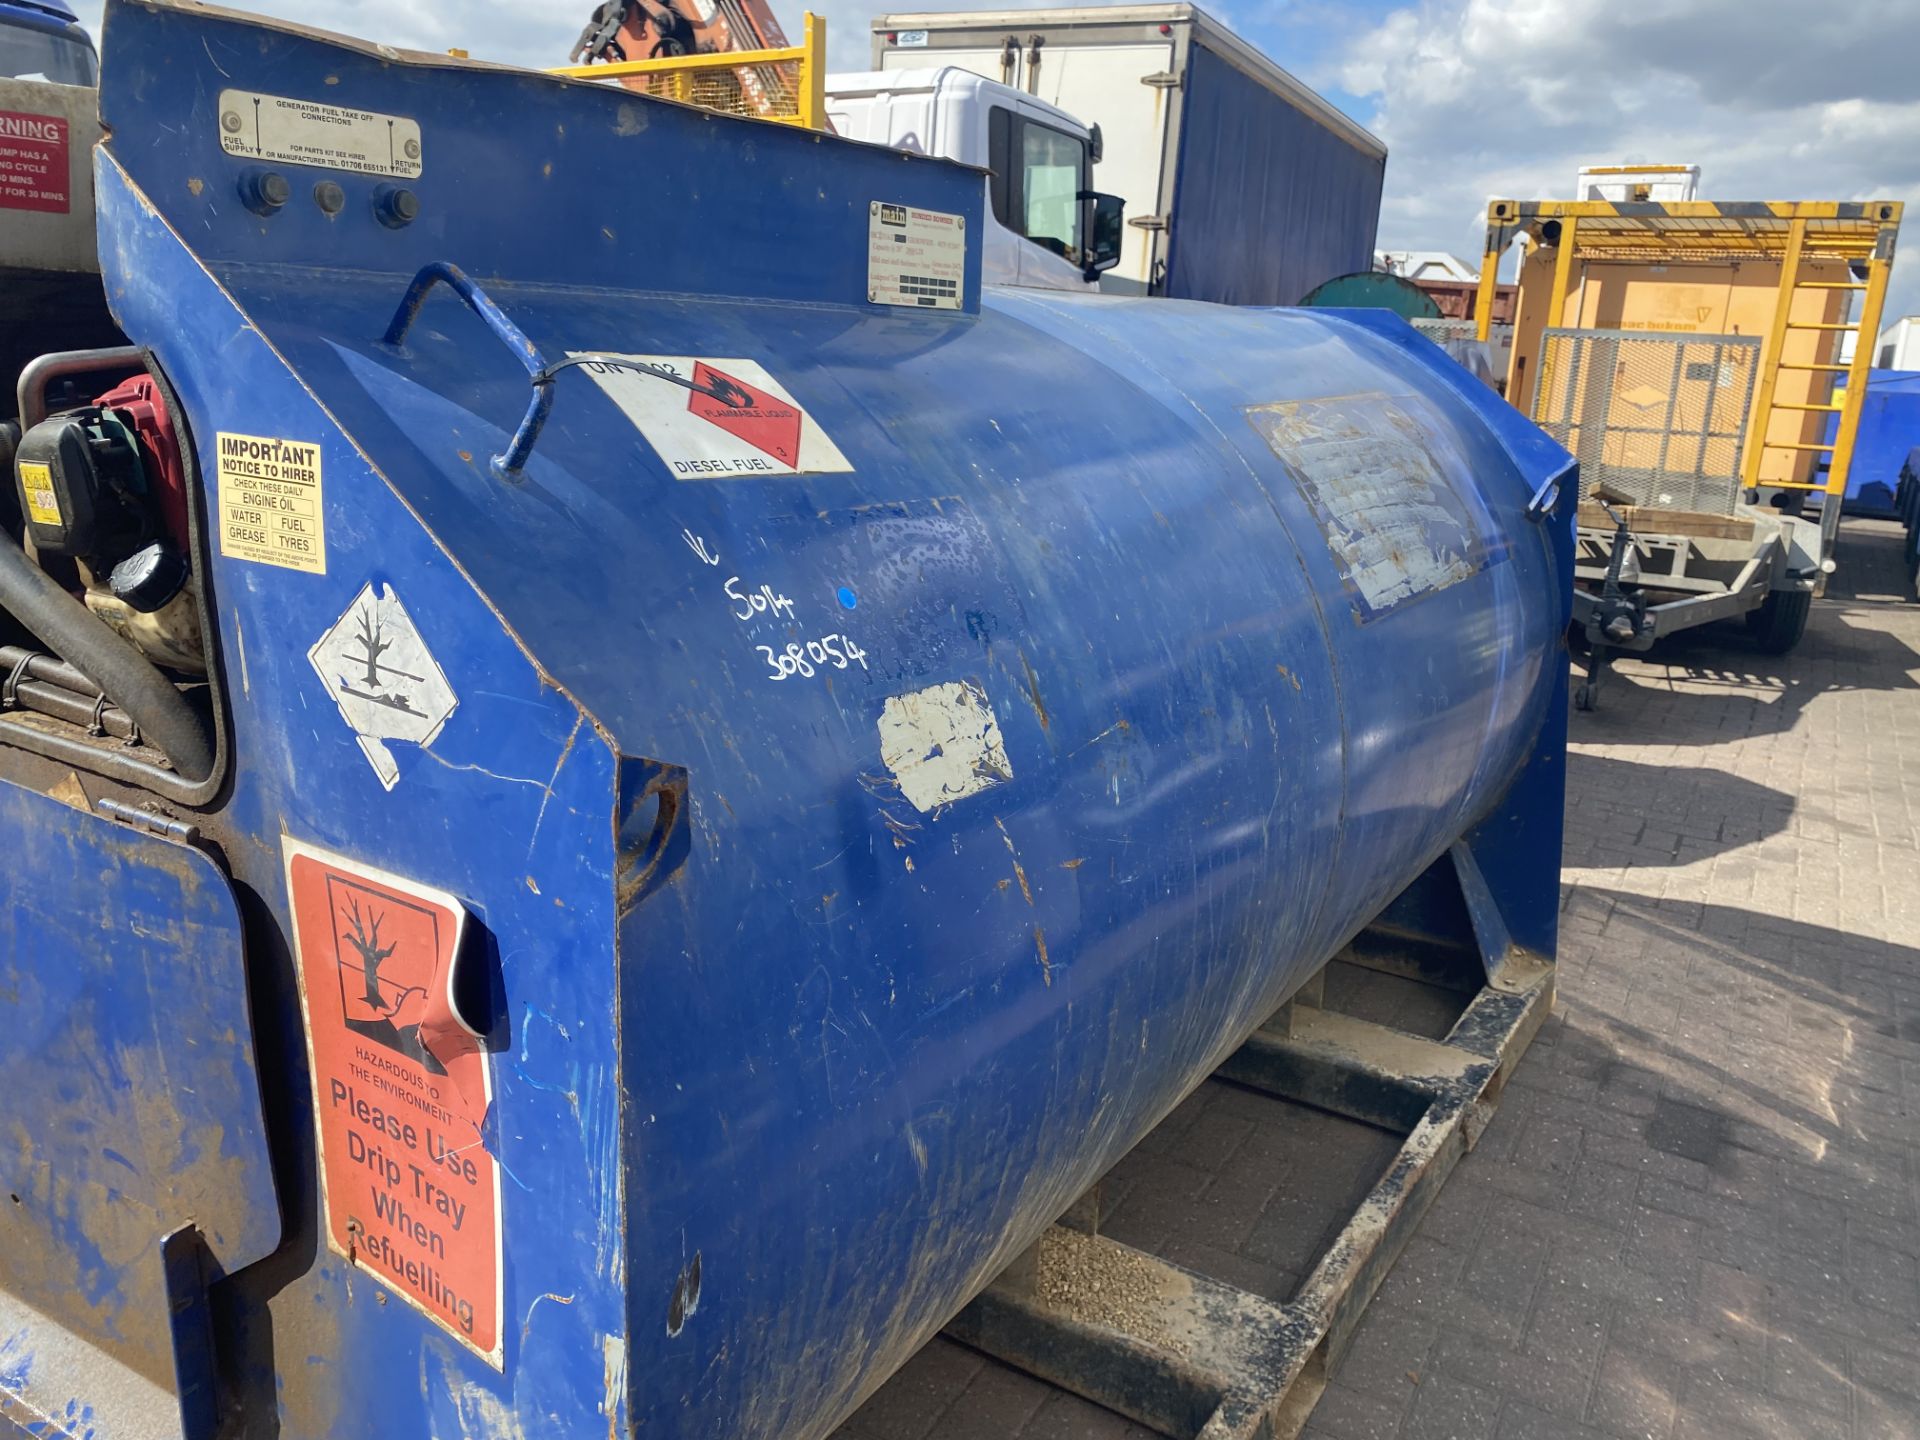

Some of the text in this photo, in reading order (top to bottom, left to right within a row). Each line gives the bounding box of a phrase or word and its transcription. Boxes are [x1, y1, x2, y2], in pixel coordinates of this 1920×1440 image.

[276, 100, 374, 122] GENERATOR FUEL TAKE OFF
[301, 112, 352, 126] CONNECTIONS
[0, 117, 60, 141] NING
[223, 136, 244, 145] FUEL
[224, 143, 254, 153] SUPPLY
[20, 150, 40, 160] HAS
[42, 153, 49, 161] A
[266, 151, 276, 159] OR
[277, 152, 326, 165] MANUFACTURER
[340, 160, 362, 170] 01706
[290, 144, 303, 152] FOR
[304, 146, 323, 155] PARTS
[335, 150, 347, 158] SEE
[348, 152, 366, 161] HIRER
[15, 162, 47, 173] CYCLE
[395, 160, 421, 169] RETURN
[395, 166, 412, 174] FUEL
[0, 174, 36, 185] 0 MINS.
[5, 187, 26, 197] FOR
[28, 190, 39, 198] 30
[41, 191, 67, 201] MINS.
[882, 207, 906, 224] main
[585, 361, 624, 374] UN
[703, 409, 793, 419] FLAMMABLE LIQUID
[222, 437, 315, 467] IMPORTANT
[776, 446, 788, 457] 3
[222, 458, 315, 483] NOTICE TO HIRER
[673, 458, 773, 474] DIESEL FUEL
[234, 478, 303, 496] CHECK THESE DAILY
[242, 492, 295, 512] ENGINE OIL
[231, 509, 306, 532] WATER FUEL
[229, 526, 310, 552] GREASE TYRES
[755, 633, 868, 681] 308054
[355, 1046, 440, 1099] HAZARDOUS TO
[349, 1063, 453, 1126] THE ENVIRONMENT
[330, 1077, 477, 1186] Please Use
[347, 1129, 466, 1231] Drip Tray
[371, 1185, 444, 1260] When
[348, 1214, 474, 1334] Refuelling
